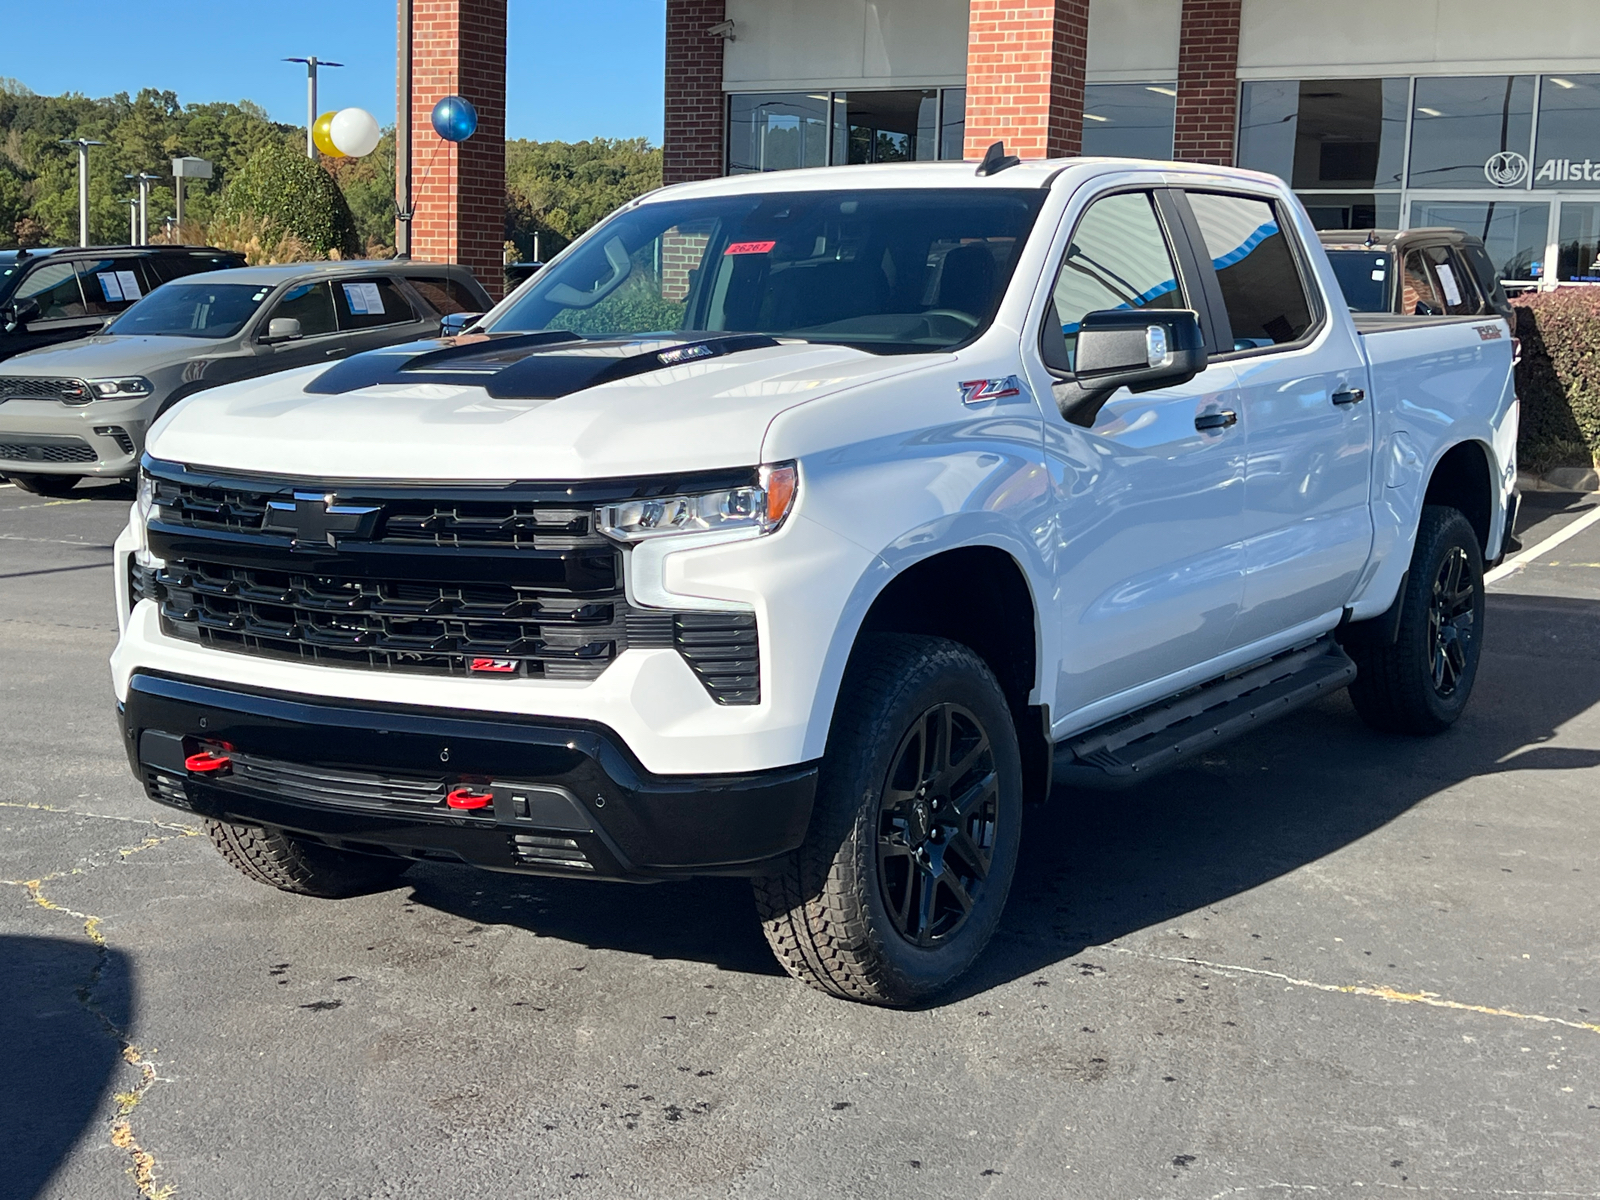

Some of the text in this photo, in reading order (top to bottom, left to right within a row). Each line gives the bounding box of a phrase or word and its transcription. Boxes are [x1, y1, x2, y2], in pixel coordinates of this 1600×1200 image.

[731, 243, 768, 253] 26267
[1472, 325, 1503, 334] TRAIL
[958, 375, 1020, 405] Z71
[470, 658, 519, 672] Z71
